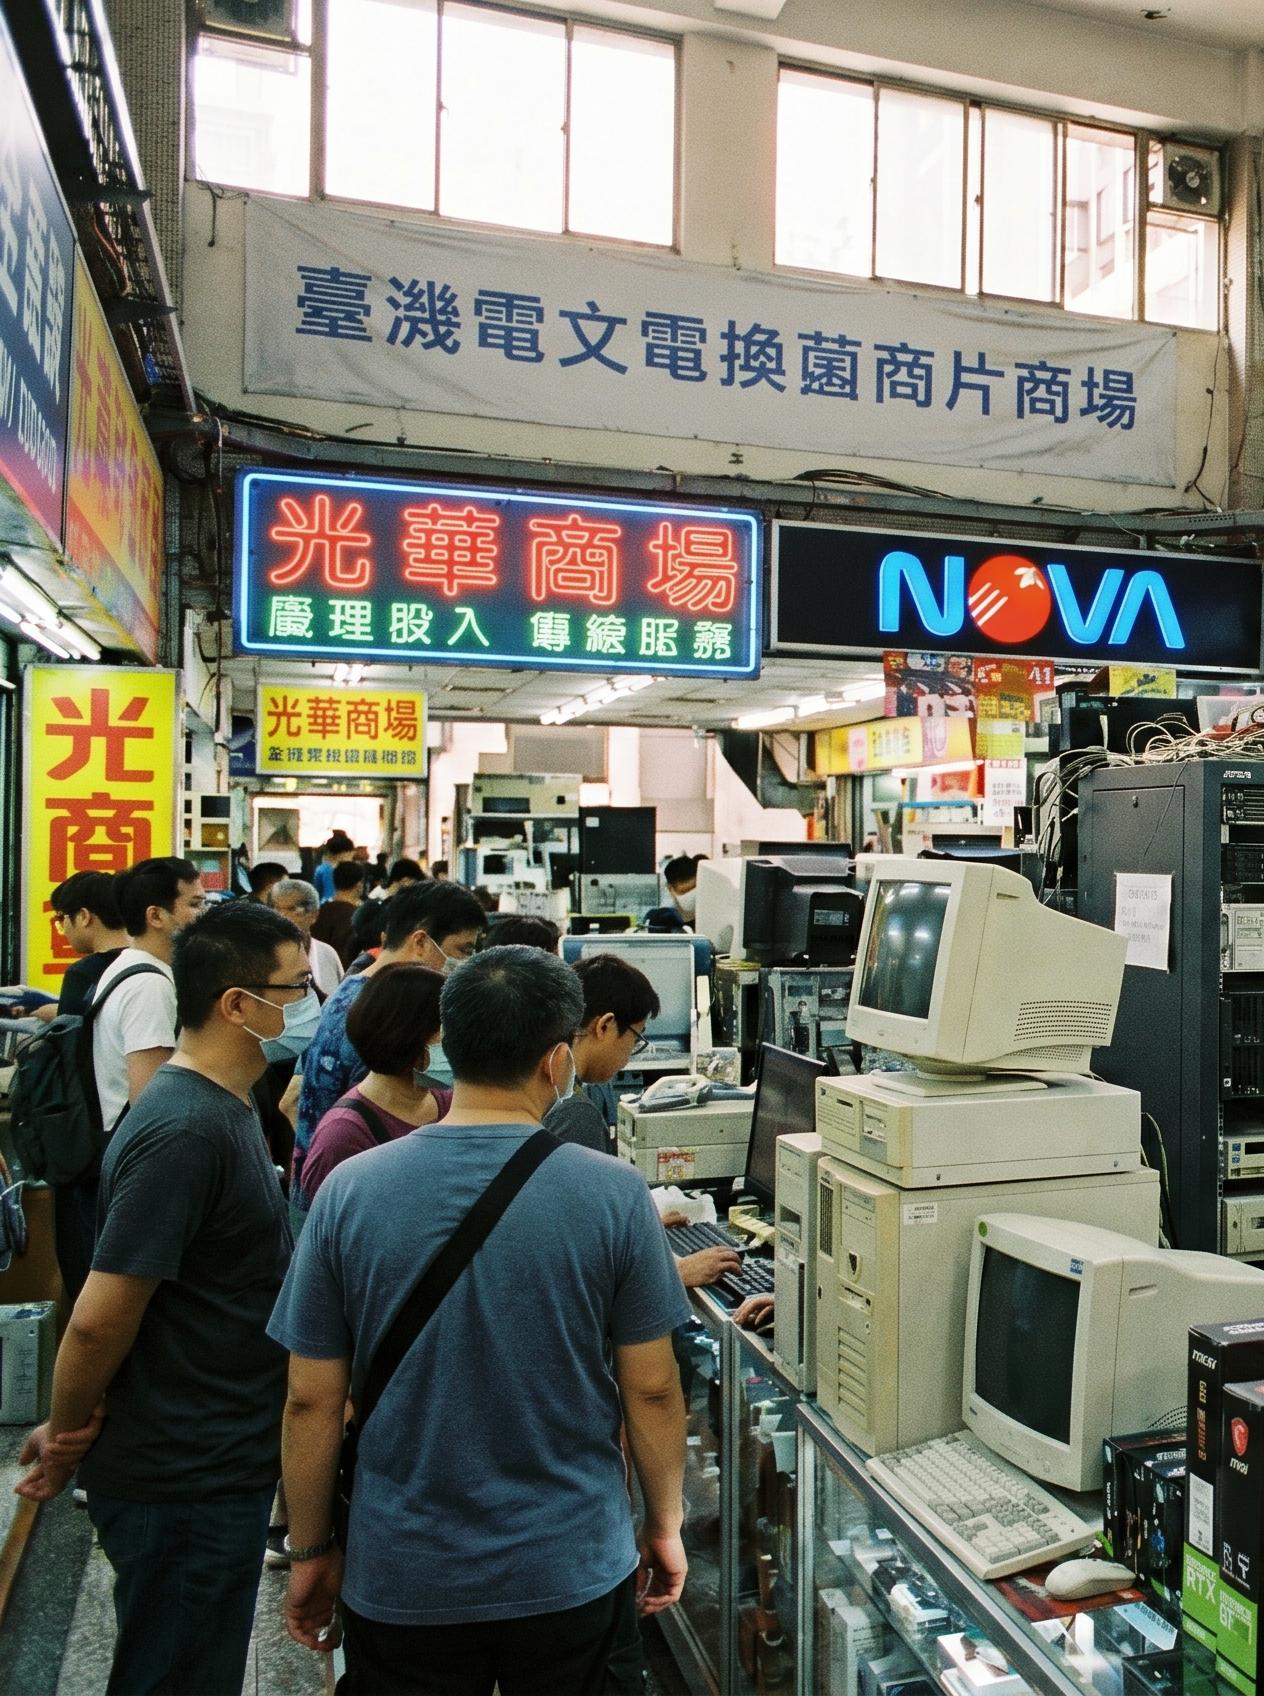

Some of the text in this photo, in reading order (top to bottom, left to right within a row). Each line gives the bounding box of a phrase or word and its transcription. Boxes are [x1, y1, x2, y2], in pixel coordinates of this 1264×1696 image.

[270, 495, 737, 612] 光華商場
[878, 550, 1186, 649] NOVA
[267, 695, 418, 741] 光華商場
